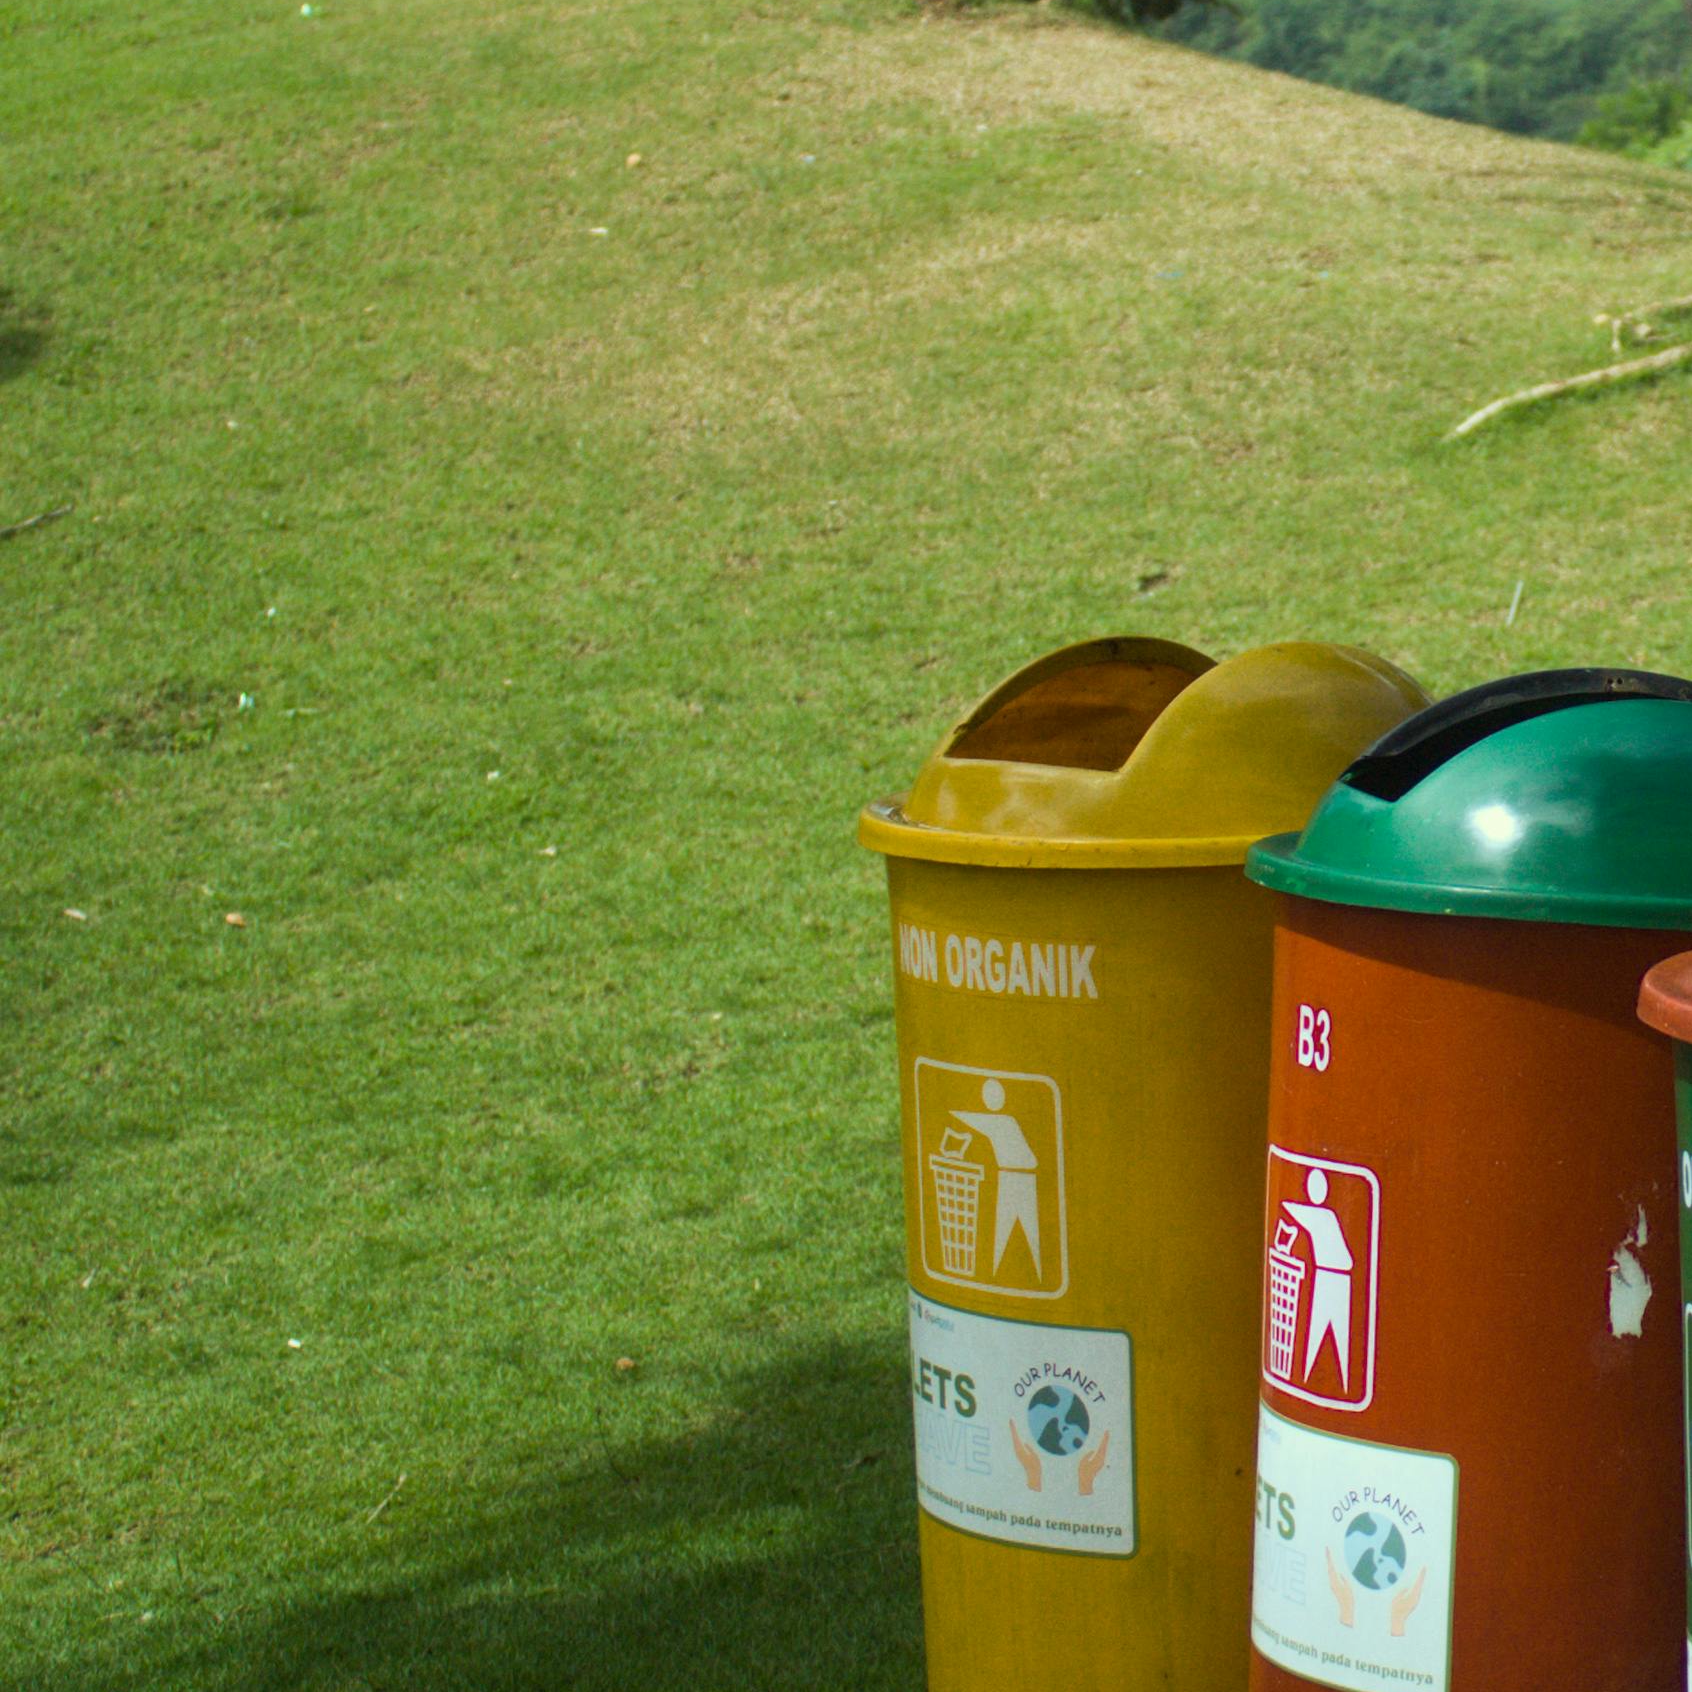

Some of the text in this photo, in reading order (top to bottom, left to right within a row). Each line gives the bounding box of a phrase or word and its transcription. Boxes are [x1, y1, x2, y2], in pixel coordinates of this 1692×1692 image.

[899, 922, 1098, 999] NON ORGANIK
[1298, 1004, 1331, 1072] B3
[1014, 1363, 1106, 1402] OUR PLANET
[920, 1411, 992, 1475] AVE
[1010, 1514, 1041, 1528] pada
[1045, 1519, 1123, 1537] tempatnya
[1332, 1486, 1425, 1534] OUR PLANET
[1321, 1651, 1351, 1668] pada
[1355, 1658, 1434, 1685] tempatnya
